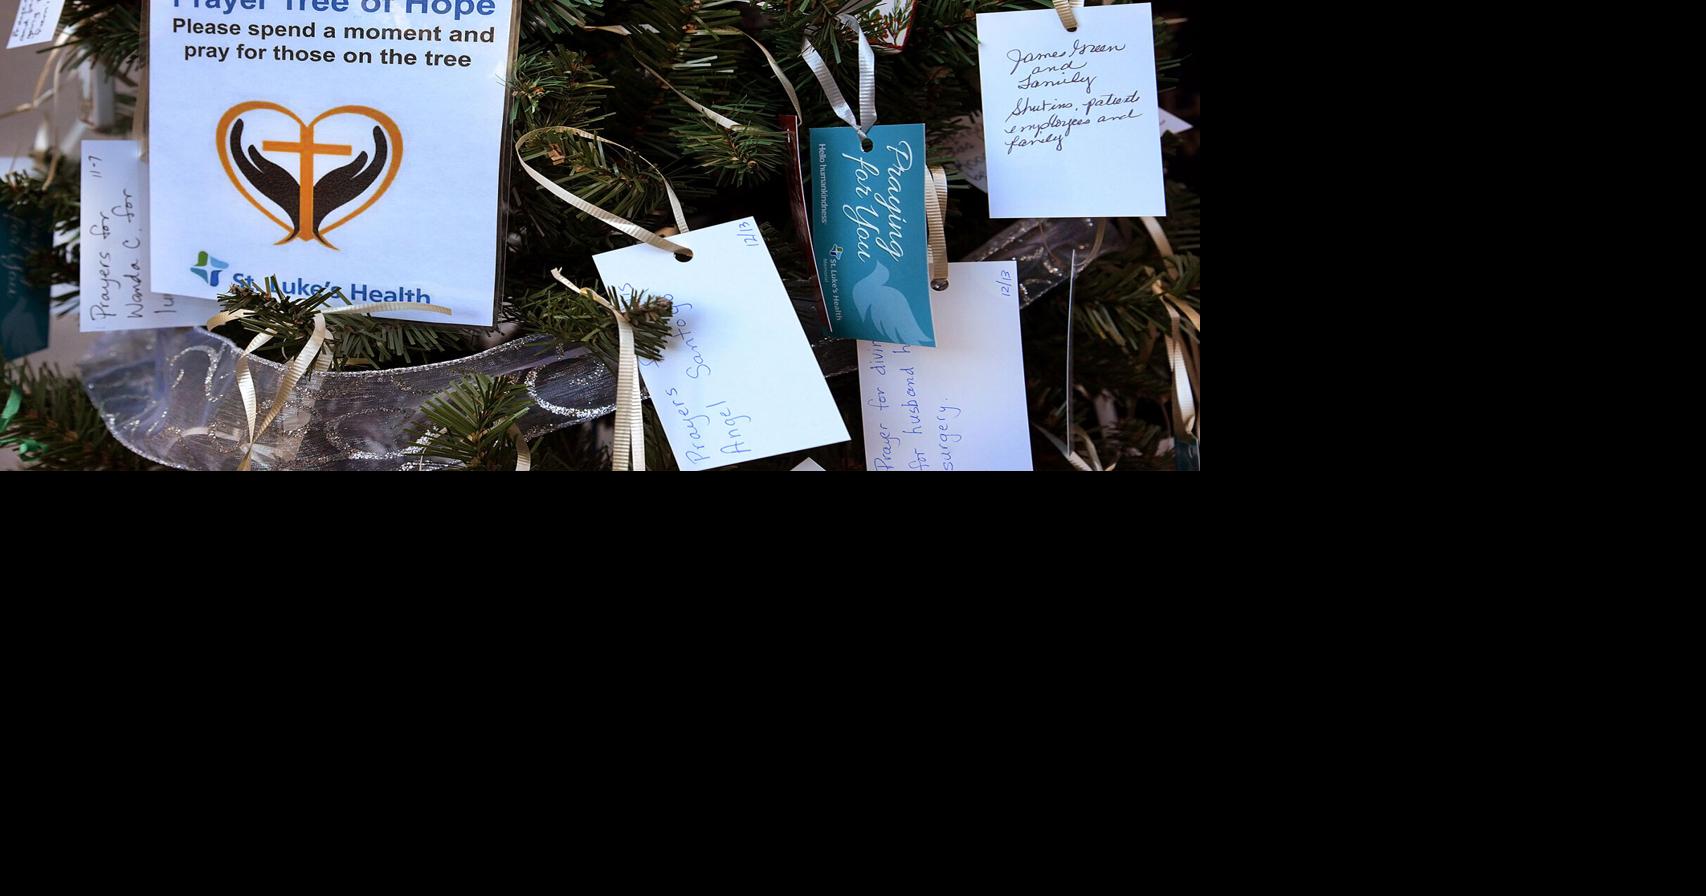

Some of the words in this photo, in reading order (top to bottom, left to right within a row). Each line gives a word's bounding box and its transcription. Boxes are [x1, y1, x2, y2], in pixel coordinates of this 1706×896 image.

[406, 0, 496, 21] Hope
[173, 18, 241, 35] Please
[248, 22, 316, 40] spend
[323, 26, 336, 39] a
[344, 26, 442, 42] moment
[449, 27, 495, 43] and
[184, 45, 230, 62] pray
[236, 44, 267, 60] for
[273, 46, 336, 62] those
[343, 51, 372, 64] on
[380, 49, 417, 65] the
[425, 51, 472, 67] tree
[1006, 49, 1067, 75] James
[1069, 39, 1126, 57] Green
[1031, 61, 1087, 75] and
[1018, 72, 1097, 93] Family
[1097, 109, 1144, 123] and
[818, 143, 827, 163] Hello
[842, 152, 880, 200] for
[112, 188, 135, 223] for
[818, 164, 828, 225] humankindness
[874, 140, 913, 262] Praying
[89, 212, 110, 240] for
[736, 221, 760, 247] 12/13
[843, 204, 880, 263] You
[90, 252, 121, 321] Prayers
[124, 259, 144, 319] Wanda
[351, 284, 431, 304] Health
[995, 270, 1012, 297] 12/13
[833, 294, 843, 321] Health
[870, 340, 887, 375] divi
[867, 387, 889, 410] for
[900, 366, 923, 434] husband
[665, 387, 711, 464] Prayers
[707, 401, 752, 454] Angel
[874, 423, 900, 471] Prayer
[908, 448, 930, 471] for
